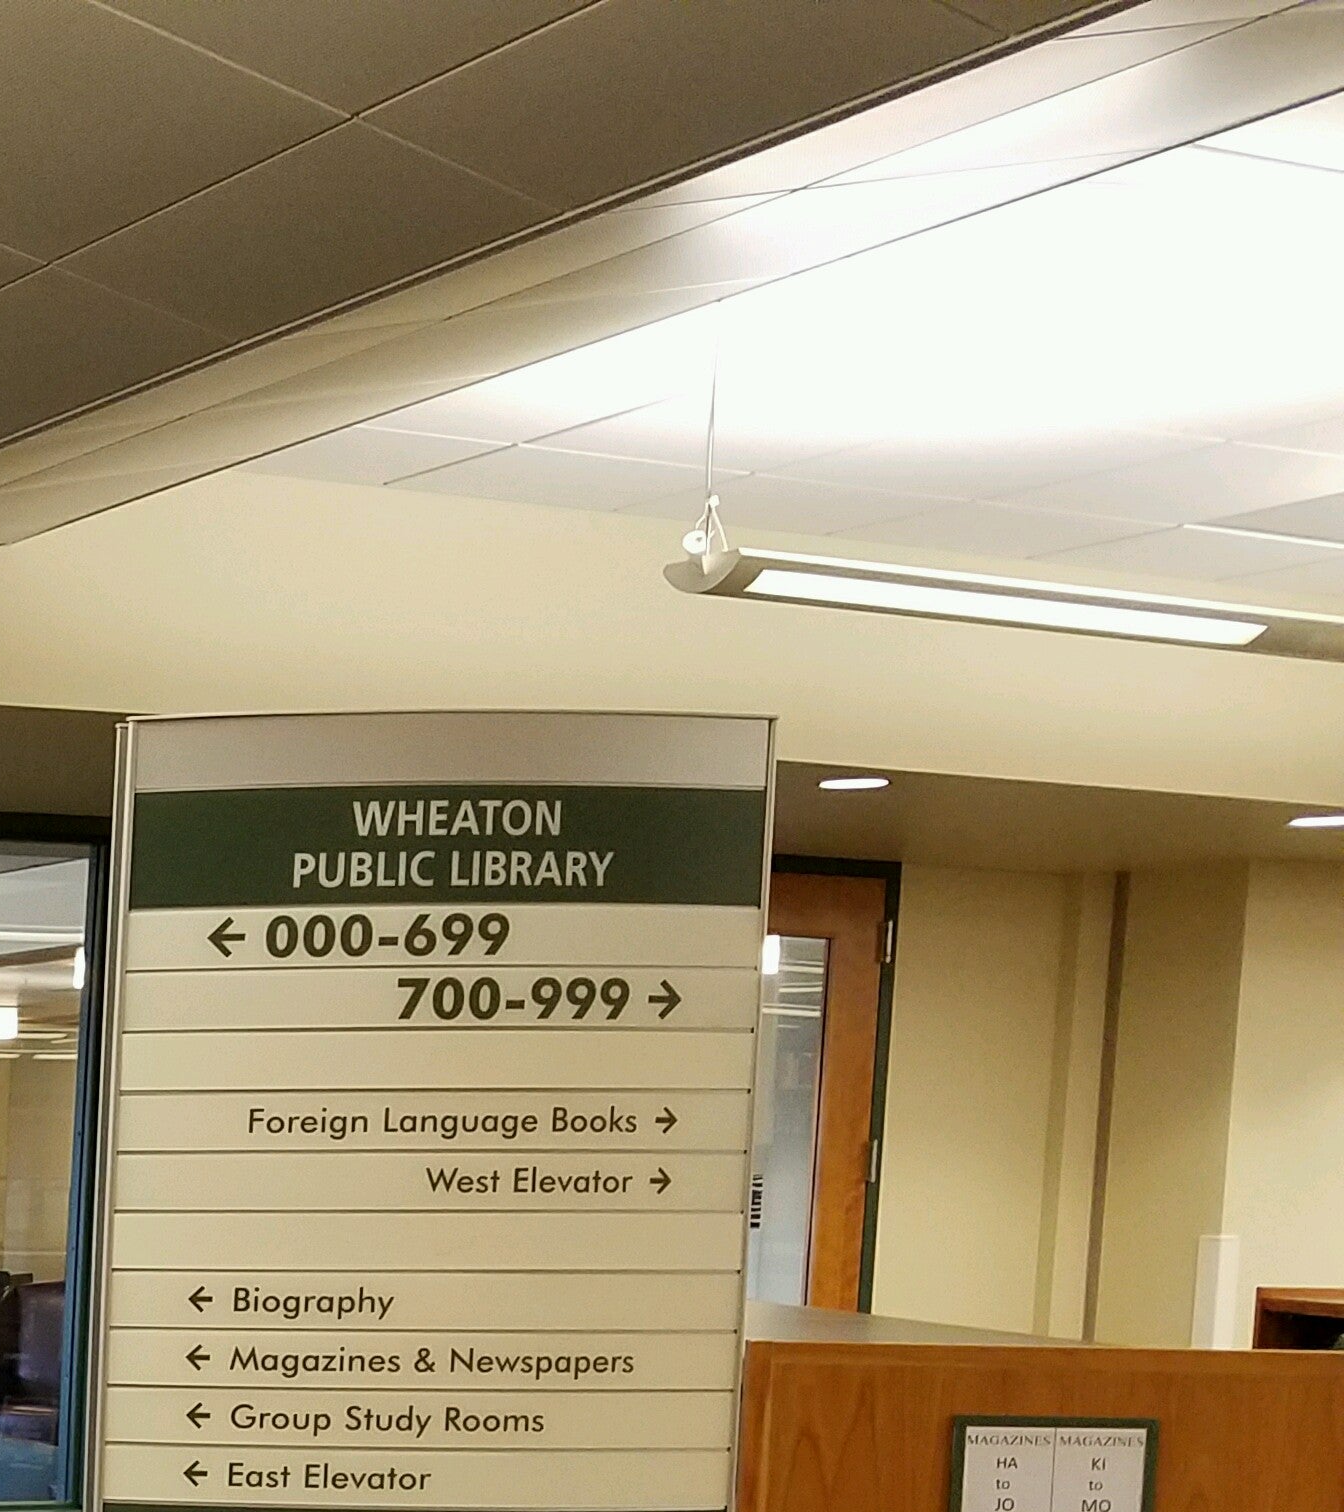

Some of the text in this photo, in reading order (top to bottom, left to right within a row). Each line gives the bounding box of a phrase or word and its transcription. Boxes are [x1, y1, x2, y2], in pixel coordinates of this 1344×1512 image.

[352, 800, 562, 837] WHEATON
[292, 851, 615, 888] PUBLIC LIBRARY
[265, 913, 511, 958] 000-699
[397, 977, 631, 1020] 700-999
[248, 1106, 638, 1140] Foreign Language Books
[426, 1167, 633, 1194] West Elevator
[233, 1287, 394, 1320] Biography
[229, 1347, 634, 1379] Magazines & Newspapers
[230, 1403, 545, 1437] Group Study Rooms
[967, 1435, 1051, 1446] MAGAZINES
[1060, 1436, 1144, 1447] MAGAZINES
[996, 1457, 1018, 1469] HA
[1091, 1458, 1106, 1471] KI
[227, 1463, 432, 1491] East Elevator
[996, 1479, 1010, 1489] to
[1089, 1480, 1103, 1490] to
[995, 1498, 1014, 1512] JO
[1082, 1499, 1111, 1512] MO
